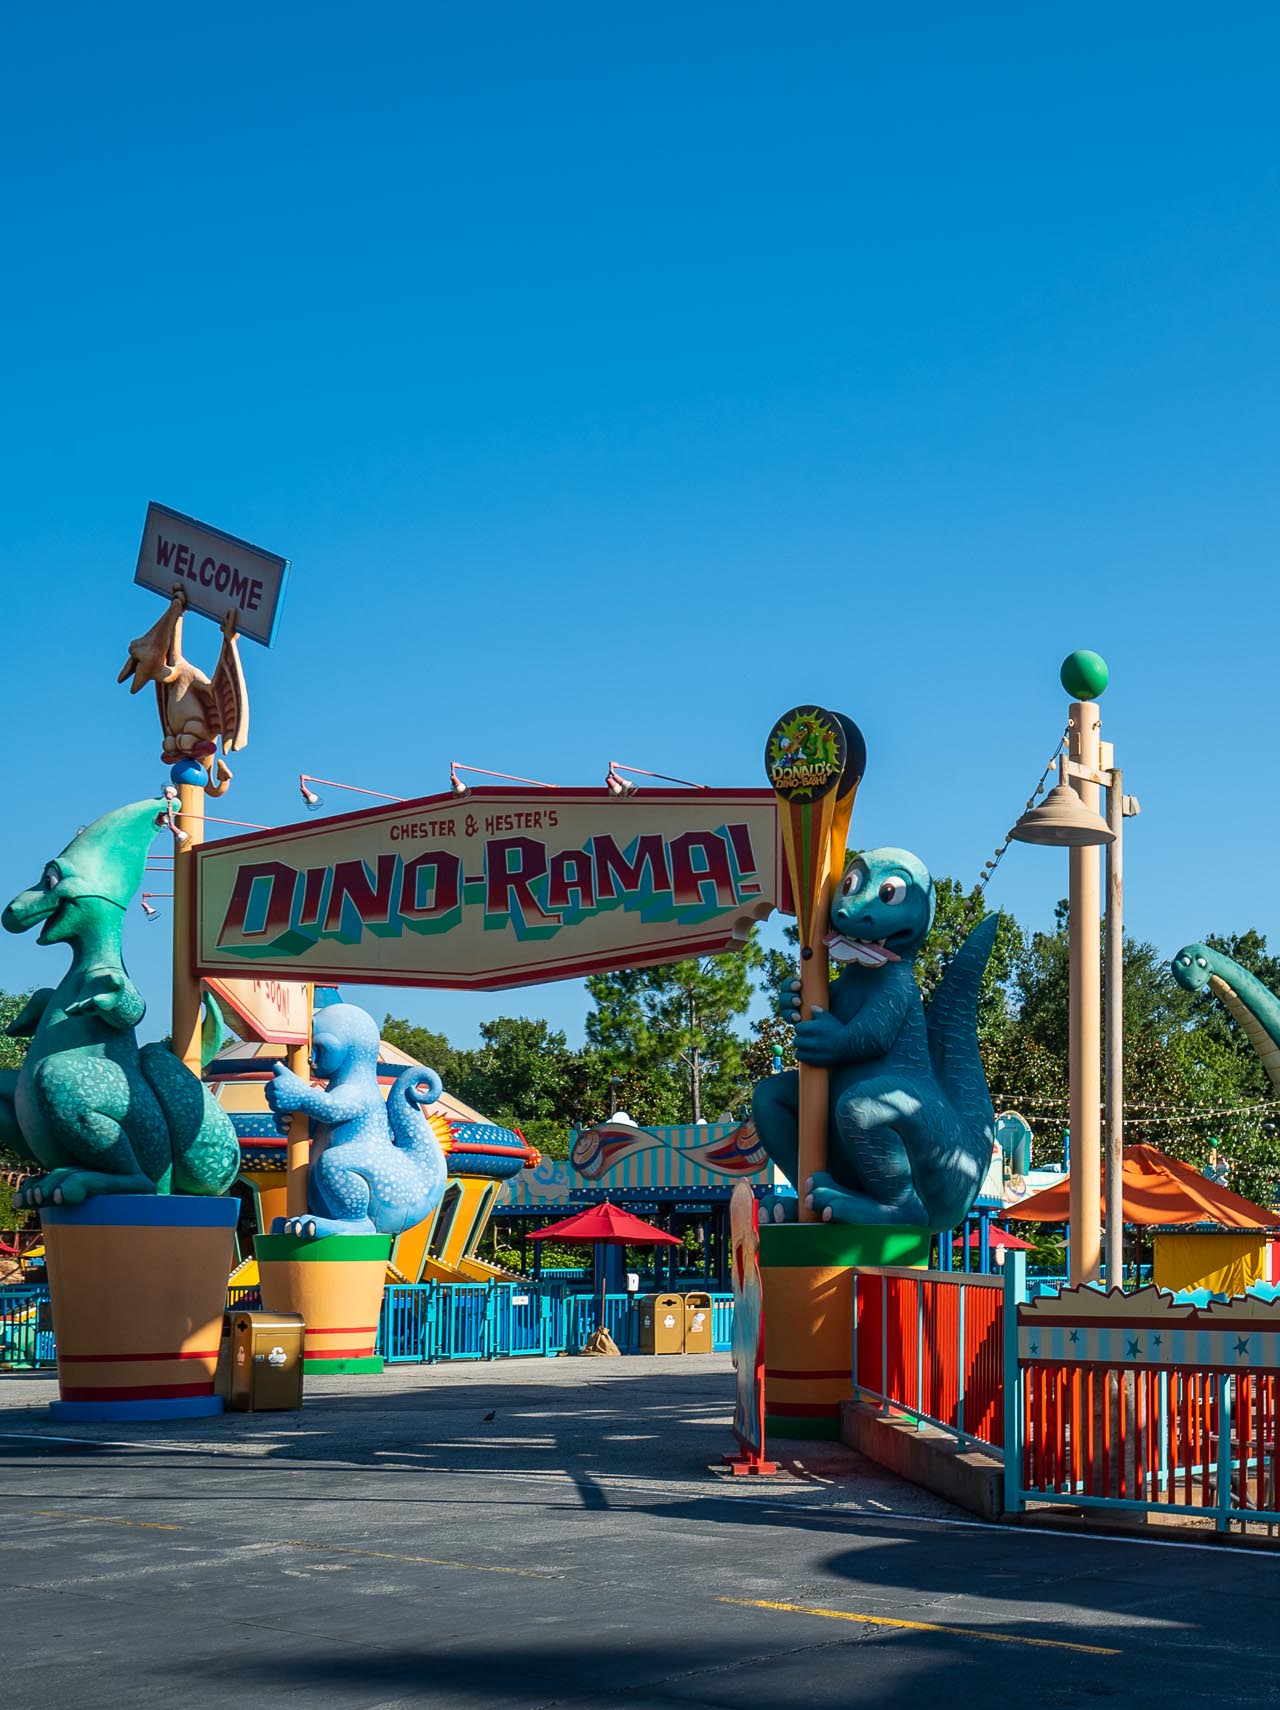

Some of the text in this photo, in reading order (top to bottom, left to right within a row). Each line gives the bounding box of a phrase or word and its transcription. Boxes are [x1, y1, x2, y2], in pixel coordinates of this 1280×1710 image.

[156, 535, 263, 610] WELCOME
[771, 761, 832, 780] DONALD'S
[389, 808, 559, 842] CHESTER & HESTER'S
[214, 822, 764, 956] DINO-RAMA!
